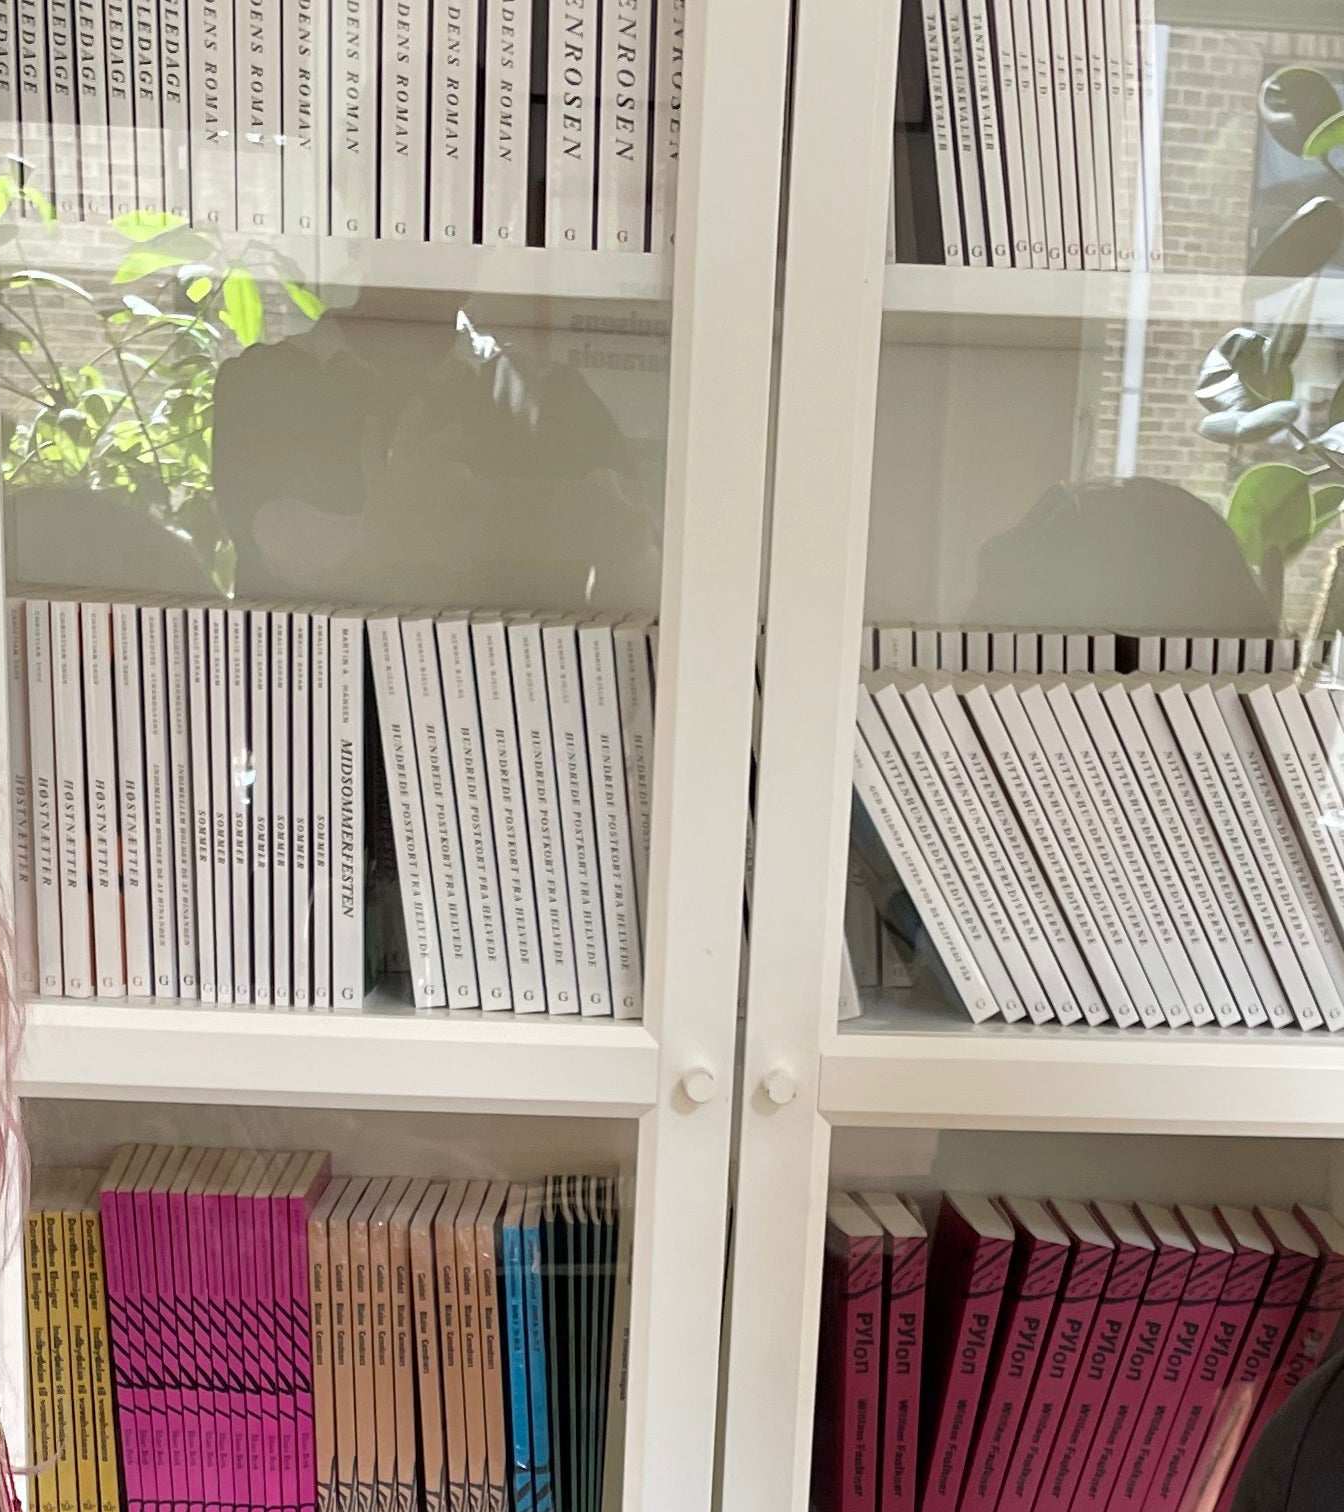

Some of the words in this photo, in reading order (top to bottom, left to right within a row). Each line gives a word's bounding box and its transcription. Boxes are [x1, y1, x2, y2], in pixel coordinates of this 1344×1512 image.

[204, 61, 220, 145] ROMAN
[298, 68, 312, 150] ROMAN
[346, 71, 359, 153] ROMAN
[396, 75, 409, 157] ROMAN
[445, 77, 460, 160] ROMAN
[499, 79, 514, 162] ROMAN
[426, 723, 444, 799] HUNDREDE
[460, 727, 478, 802] HUNDREDE
[495, 729, 512, 802] HUNDREDE
[531, 730, 548, 804] HUNDREDE
[564, 732, 582, 806] HUNDREDE
[197, 810, 208, 863] SOMMER
[216, 812, 226, 865] SOMMER
[236, 812, 245, 865] SOMMER
[257, 816, 266, 869] SOMMER
[277, 815, 285, 867] SOMMER
[340, 738, 354, 919] MIDSOMMERFESTEN
[435, 803, 452, 870] POSTKORT
[470, 806, 486, 879] POSTKORT
[504, 808, 520, 881] POSTKORT
[539, 809, 554, 881] POSTKORT
[573, 811, 587, 879] POSTKORT
[444, 873, 455, 898] FRA
[479, 876, 489, 900] FRA
[511, 878, 522, 902] FRA
[546, 880, 557, 903] FRA
[579, 881, 590, 905] FRA
[447, 902, 464, 960] HELVEDE
[481, 904, 497, 962] HELVEDE
[515, 907, 529, 965] HELVEDE
[550, 909, 564, 966] HELVEDE
[582, 910, 597, 967] HELVEDE
[341, 987, 354, 1001] G
[458, 985, 469, 997] G
[558, 990, 569, 1003] G
